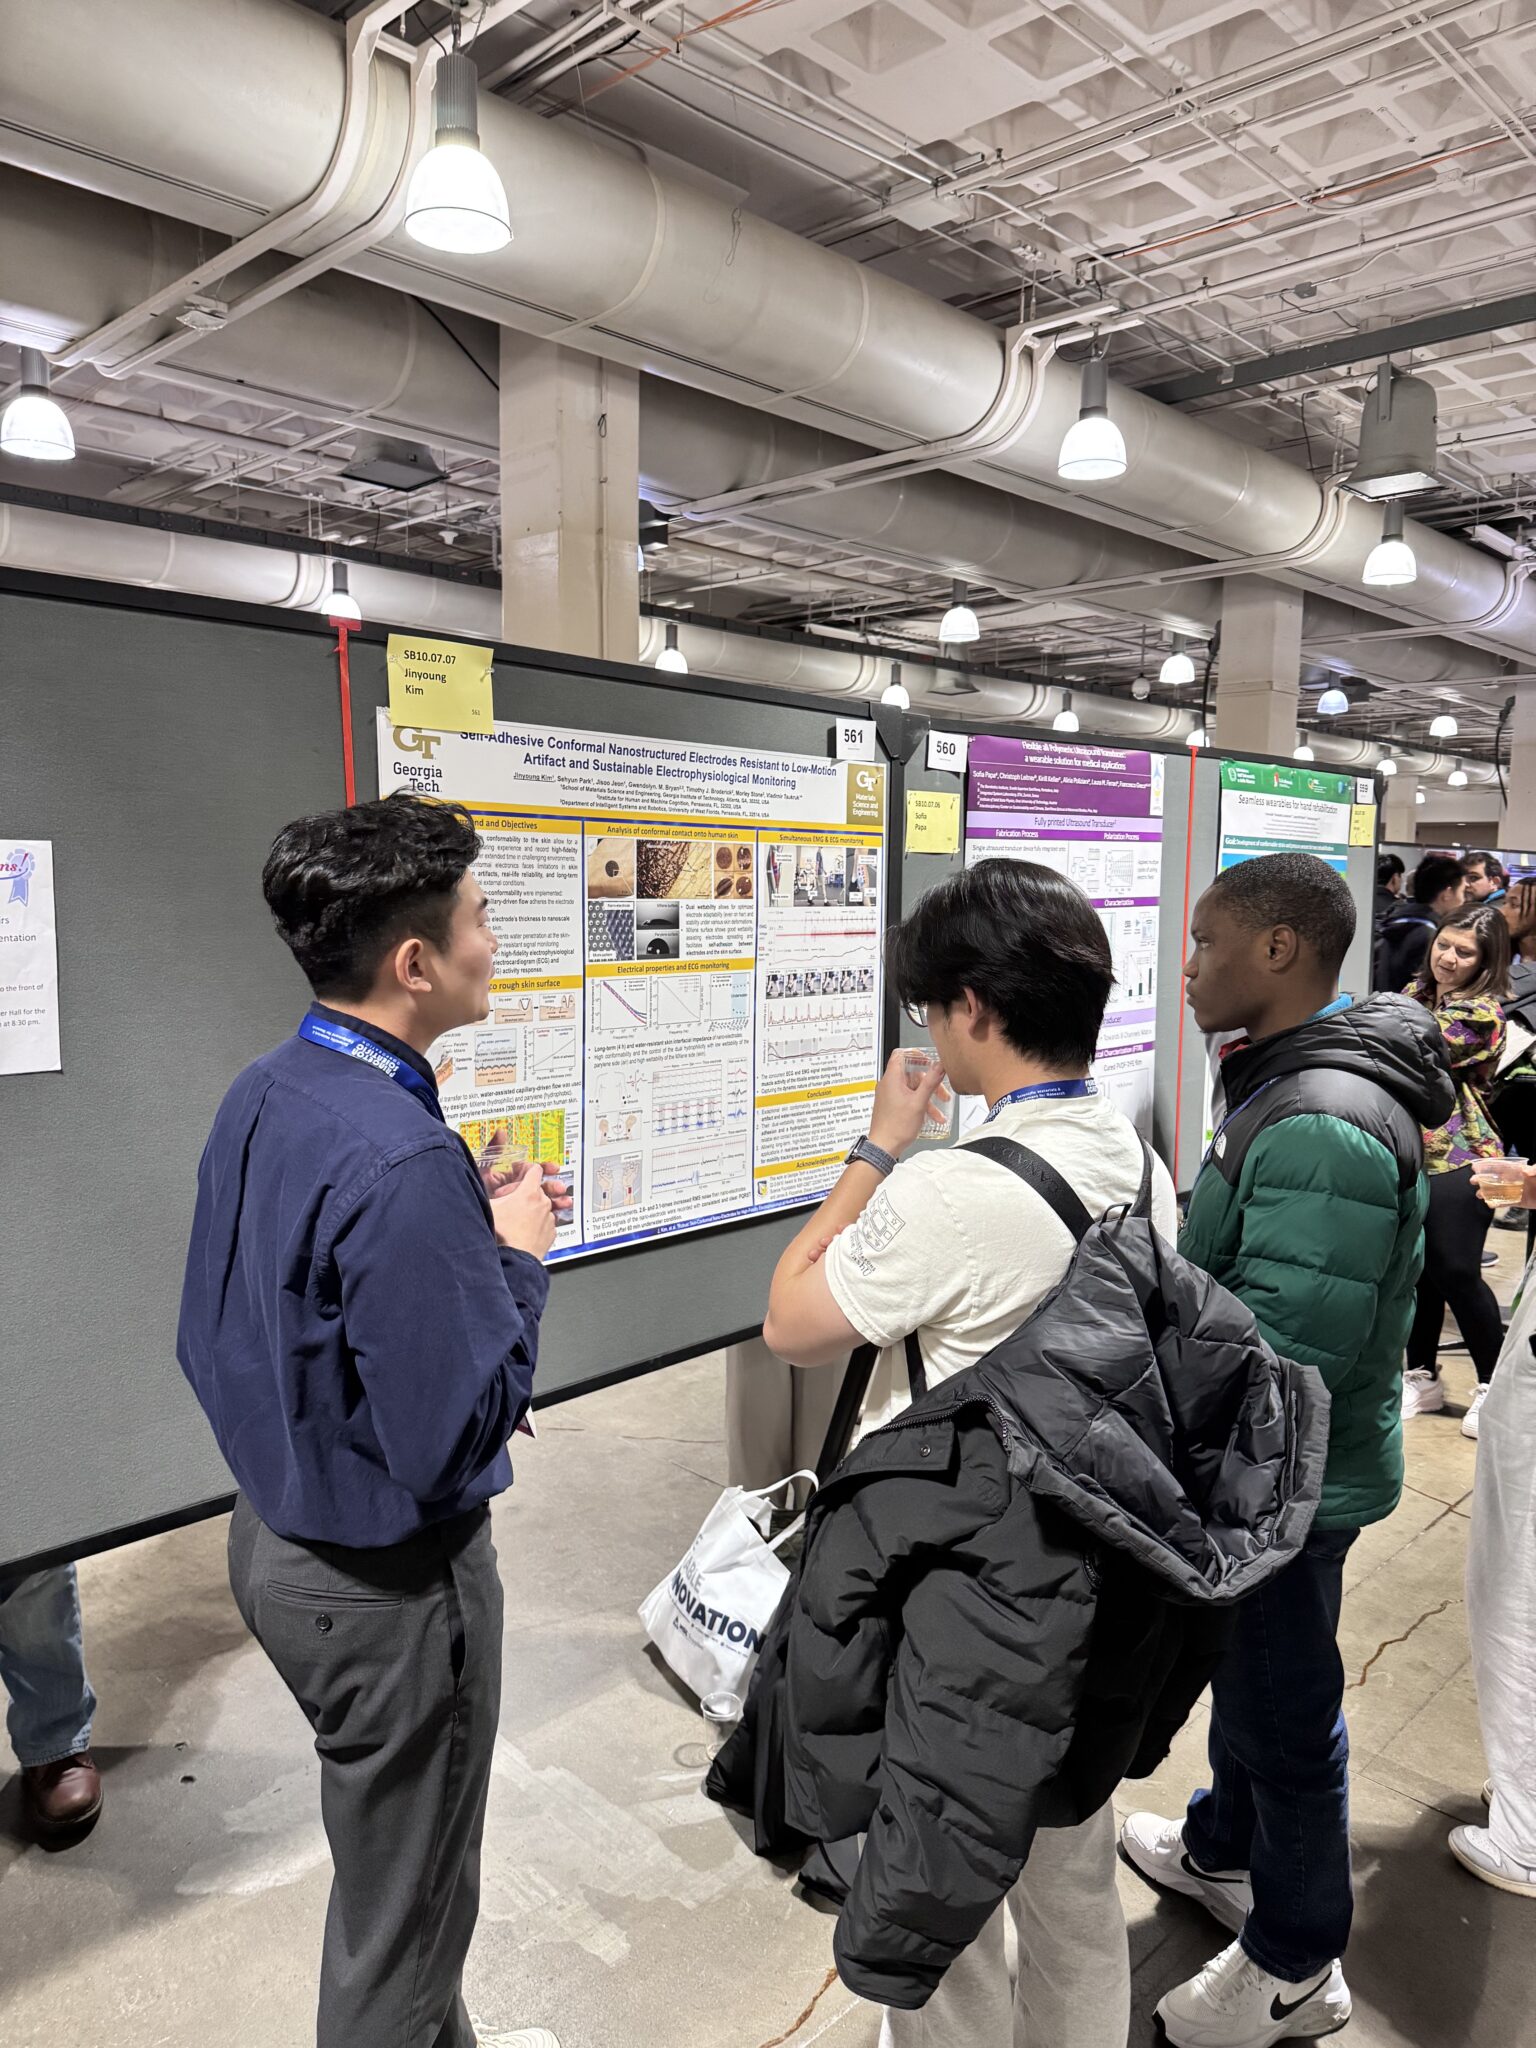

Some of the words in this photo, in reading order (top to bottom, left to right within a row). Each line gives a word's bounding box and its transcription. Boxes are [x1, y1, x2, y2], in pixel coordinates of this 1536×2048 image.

[404, 649, 456, 664] SB10.07.07
[404, 668, 447, 683] Jinyoung
[405, 684, 424, 695] Kim
[844, 729, 864, 744] 561
[936, 741, 956, 755] 560
[547, 736, 605, 754] Conformal
[608, 743, 687, 761] Nanostructured
[689, 751, 737, 767] Electrodes
[740, 756, 779, 771] Resistant
[781, 763, 790, 772] to
[791, 763, 837, 777] Low-Motion
[1029, 756, 1052, 764] wearable
[1053, 758, 1073, 766] solution
[393, 762, 443, 780] Georgia
[513, 772, 540, 781] Jinyoung
[523, 752, 566, 767] Artifact
[569, 758, 590, 770] and
[592, 759, 653, 776] Sustainable
[656, 765, 750, 785] Electrophysiological
[752, 774, 796, 790] Monitoring
[856, 793, 876, 801] Materials
[1238, 794, 1265, 806] Seamless
[1266, 799, 1292, 809] wearables
[852, 800, 869, 809] Science
[852, 808, 878, 818] Engineering
[486, 819, 499, 828] and
[501, 820, 538, 831] Objectives
[1034, 817, 1046, 828] Fully
[1047, 818, 1065, 829] printed
[1066, 819, 1092, 828] Ultrasound
[607, 825, 632, 836] Analysis
[633, 826, 640, 834] of
[640, 827, 671, 836] conformal
[671, 829, 693, 837] contact
[707, 831, 727, 839] human
[779, 834, 812, 842] Simultaneous
[996, 829, 1021, 838] Fabrication
[617, 965, 644, 974] Electrical
[645, 963, 675, 974] properties
[676, 962, 687, 970] and
[688, 961, 700, 970] ECG
[700, 960, 730, 970] monitoring
[499, 982, 520, 992] rough
[521, 980, 536, 989] skin
[536, 979, 560, 988] surface
[807, 1090, 832, 1098] Conclusion
